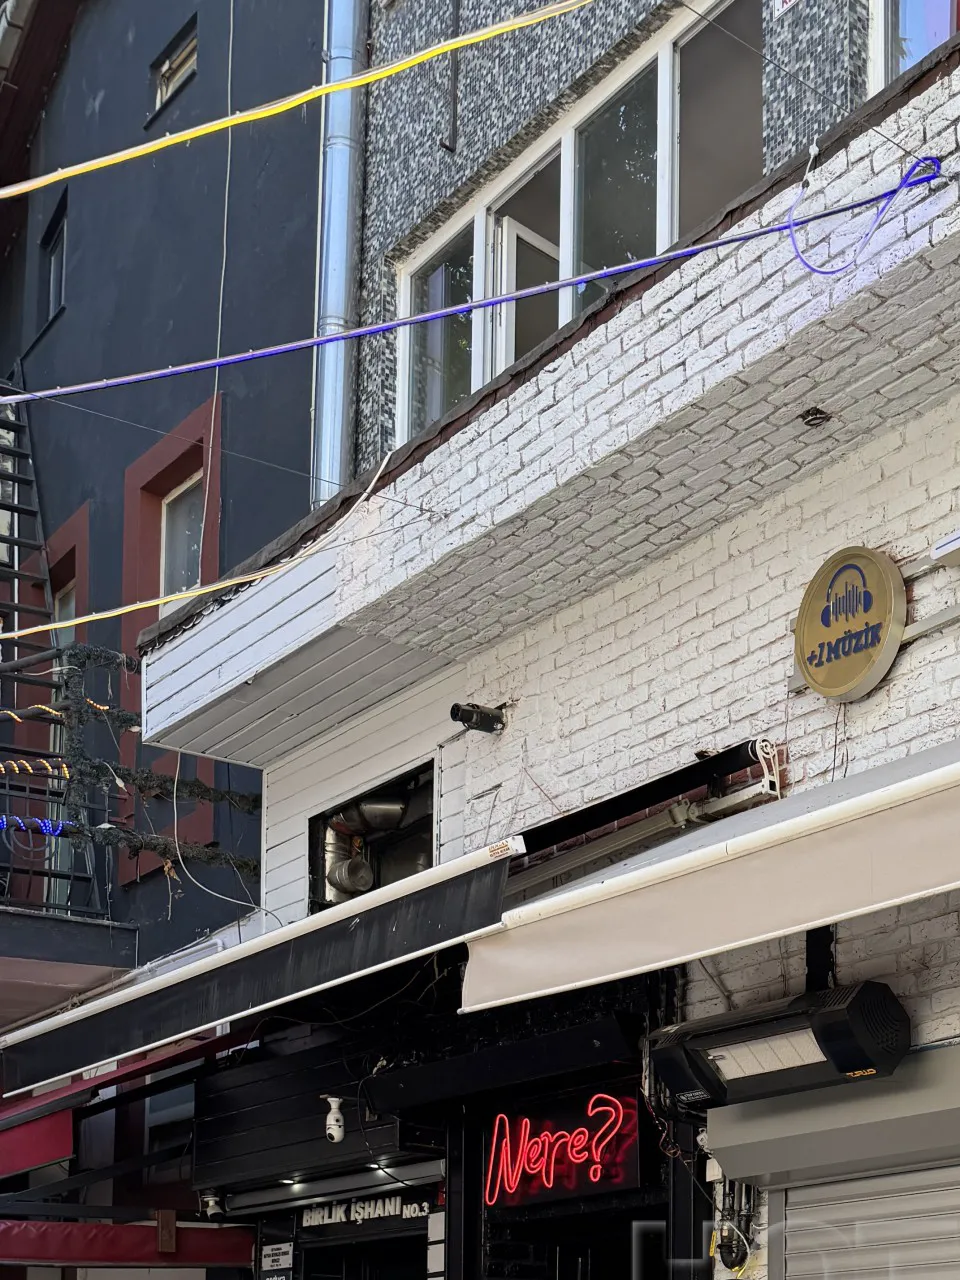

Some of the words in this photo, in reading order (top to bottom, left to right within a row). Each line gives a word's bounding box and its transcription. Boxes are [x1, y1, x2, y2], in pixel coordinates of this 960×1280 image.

[826, 621, 883, 664] MÜZİK
[485, 1093, 624, 1206] Nere?
[302, 1200, 348, 1228] BİRLİK
[349, 1196, 402, 1225] İŞHANI
[402, 1202, 430, 1219] NO.3
